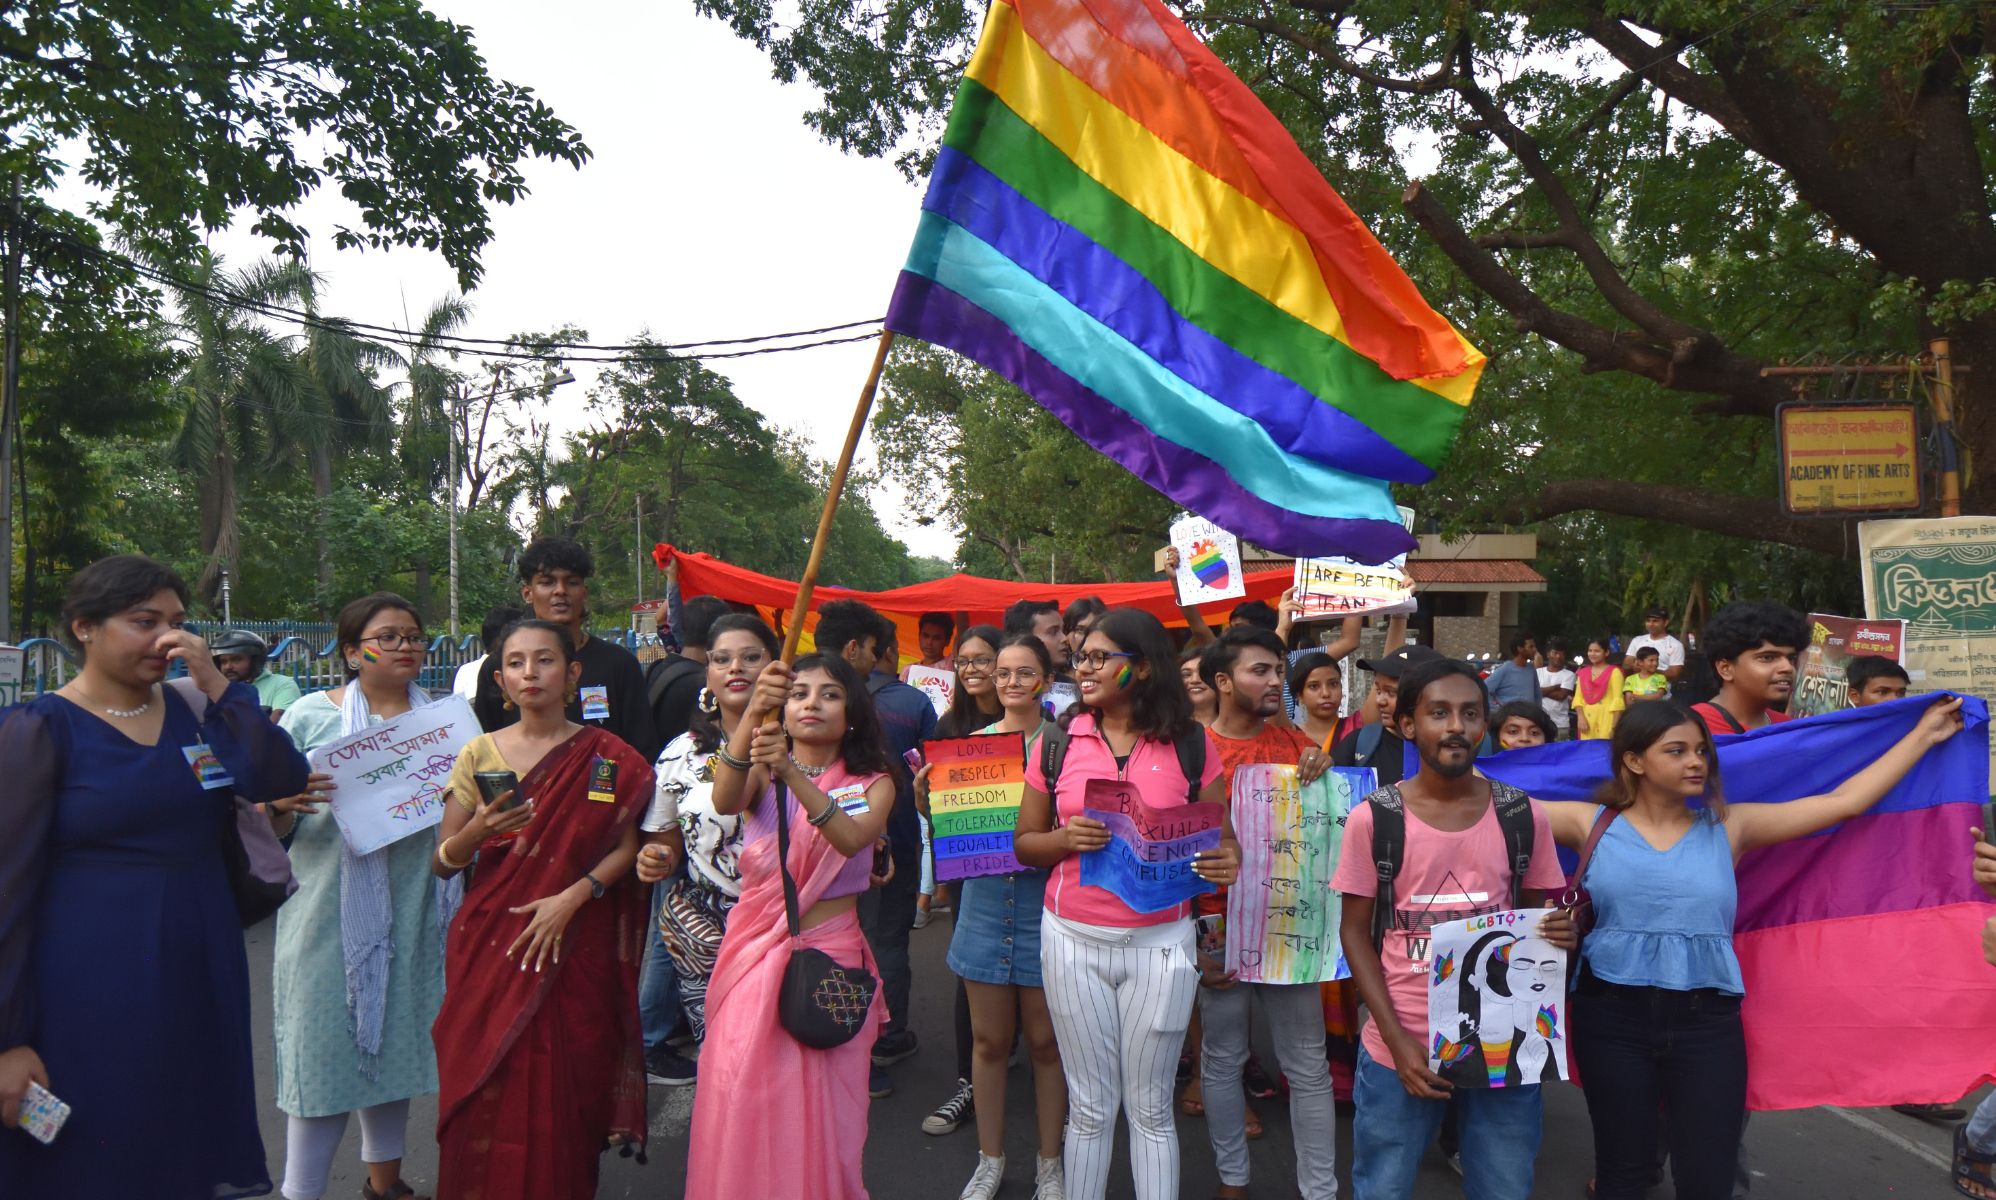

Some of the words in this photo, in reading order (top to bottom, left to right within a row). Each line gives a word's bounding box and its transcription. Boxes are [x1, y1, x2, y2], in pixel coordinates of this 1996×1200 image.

[1790, 465, 1839, 480] ACADEMY
[1843, 464, 1856, 480] OF
[1858, 464, 1880, 478] FINE
[1884, 463, 1910, 478] ARTS
[1314, 566, 1342, 584] ARE
[325, 725, 400, 768] তোমার
[386, 722, 456, 756] আমার
[957, 743, 994, 757] LOVE
[948, 763, 1009, 783] RESPECT
[943, 789, 1007, 807] FREEDOM
[945, 811, 1019, 833] TOLERANCE
[948, 834, 1011, 854] EQUALIT
[1166, 839, 1203, 862] NOT
[963, 855, 1013, 872] PRIDE
[1122, 845, 1192, 882] CONFUSE
